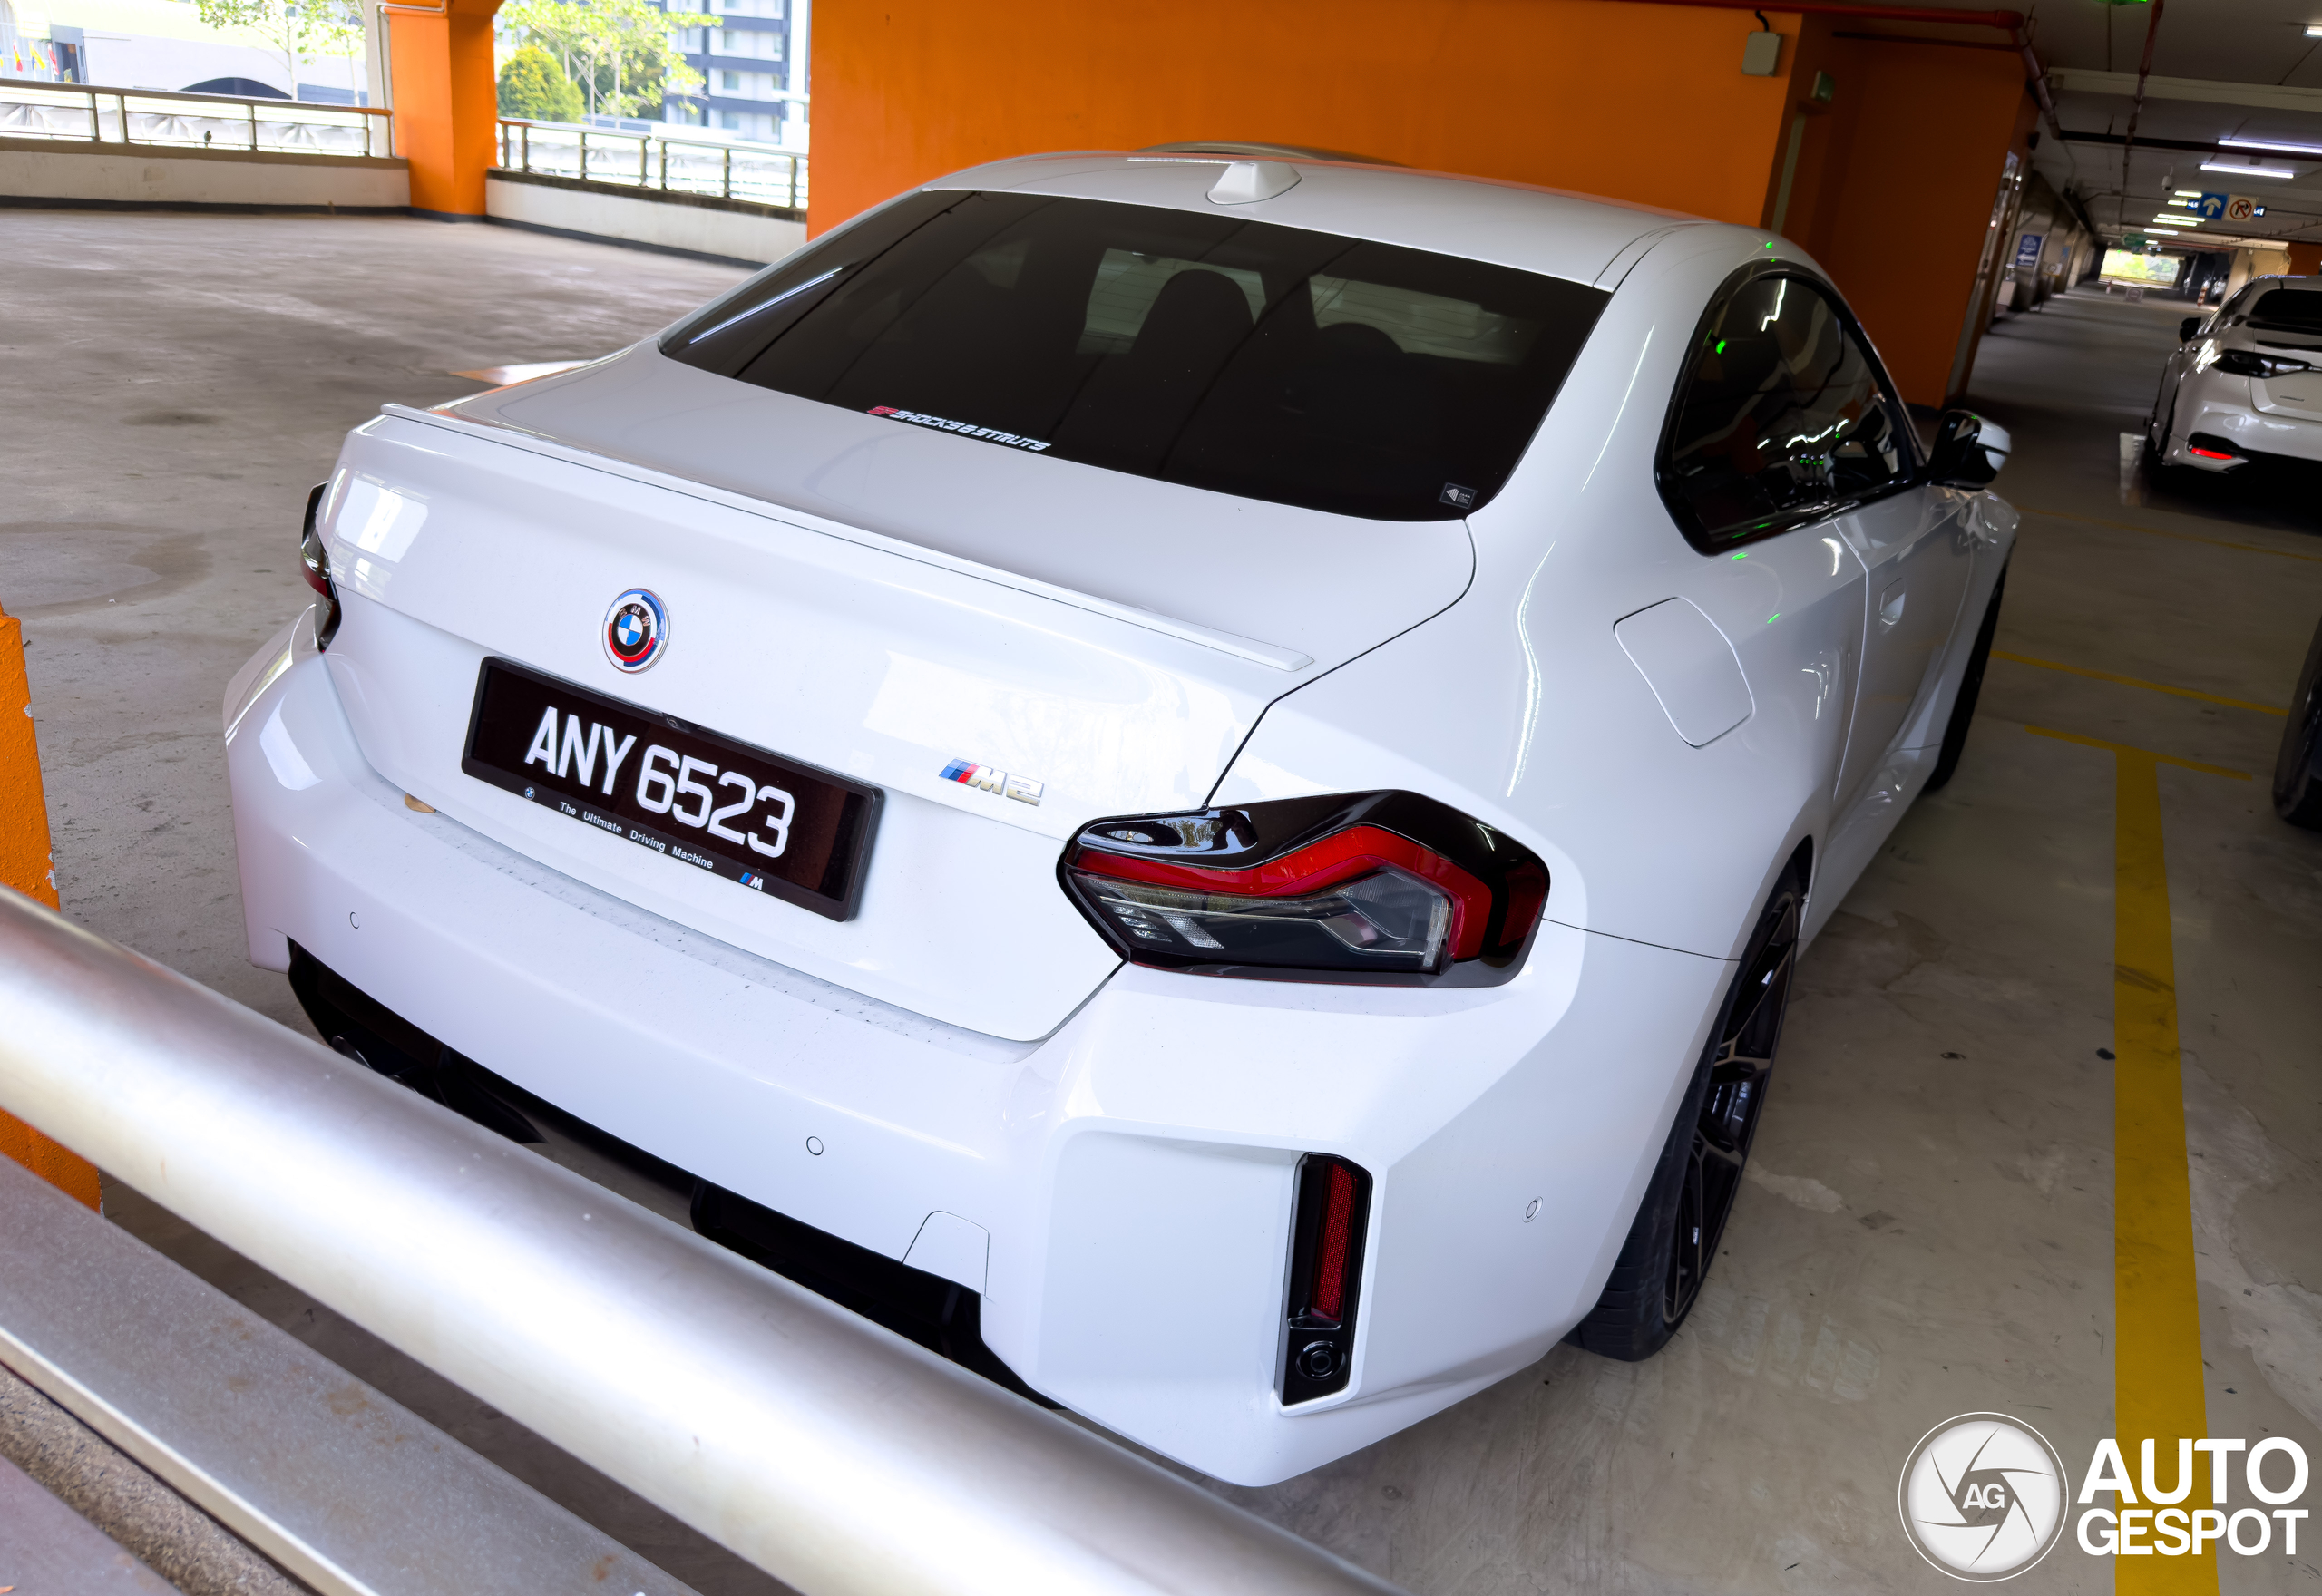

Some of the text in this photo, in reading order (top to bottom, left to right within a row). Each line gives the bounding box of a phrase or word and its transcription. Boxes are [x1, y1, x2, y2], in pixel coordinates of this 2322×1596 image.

[619, 605, 651, 627] BMW
[525, 706, 795, 858] ANY 6523
[966, 764, 1044, 807] M2
[560, 802, 714, 870] The Ultimate Driving Machine
